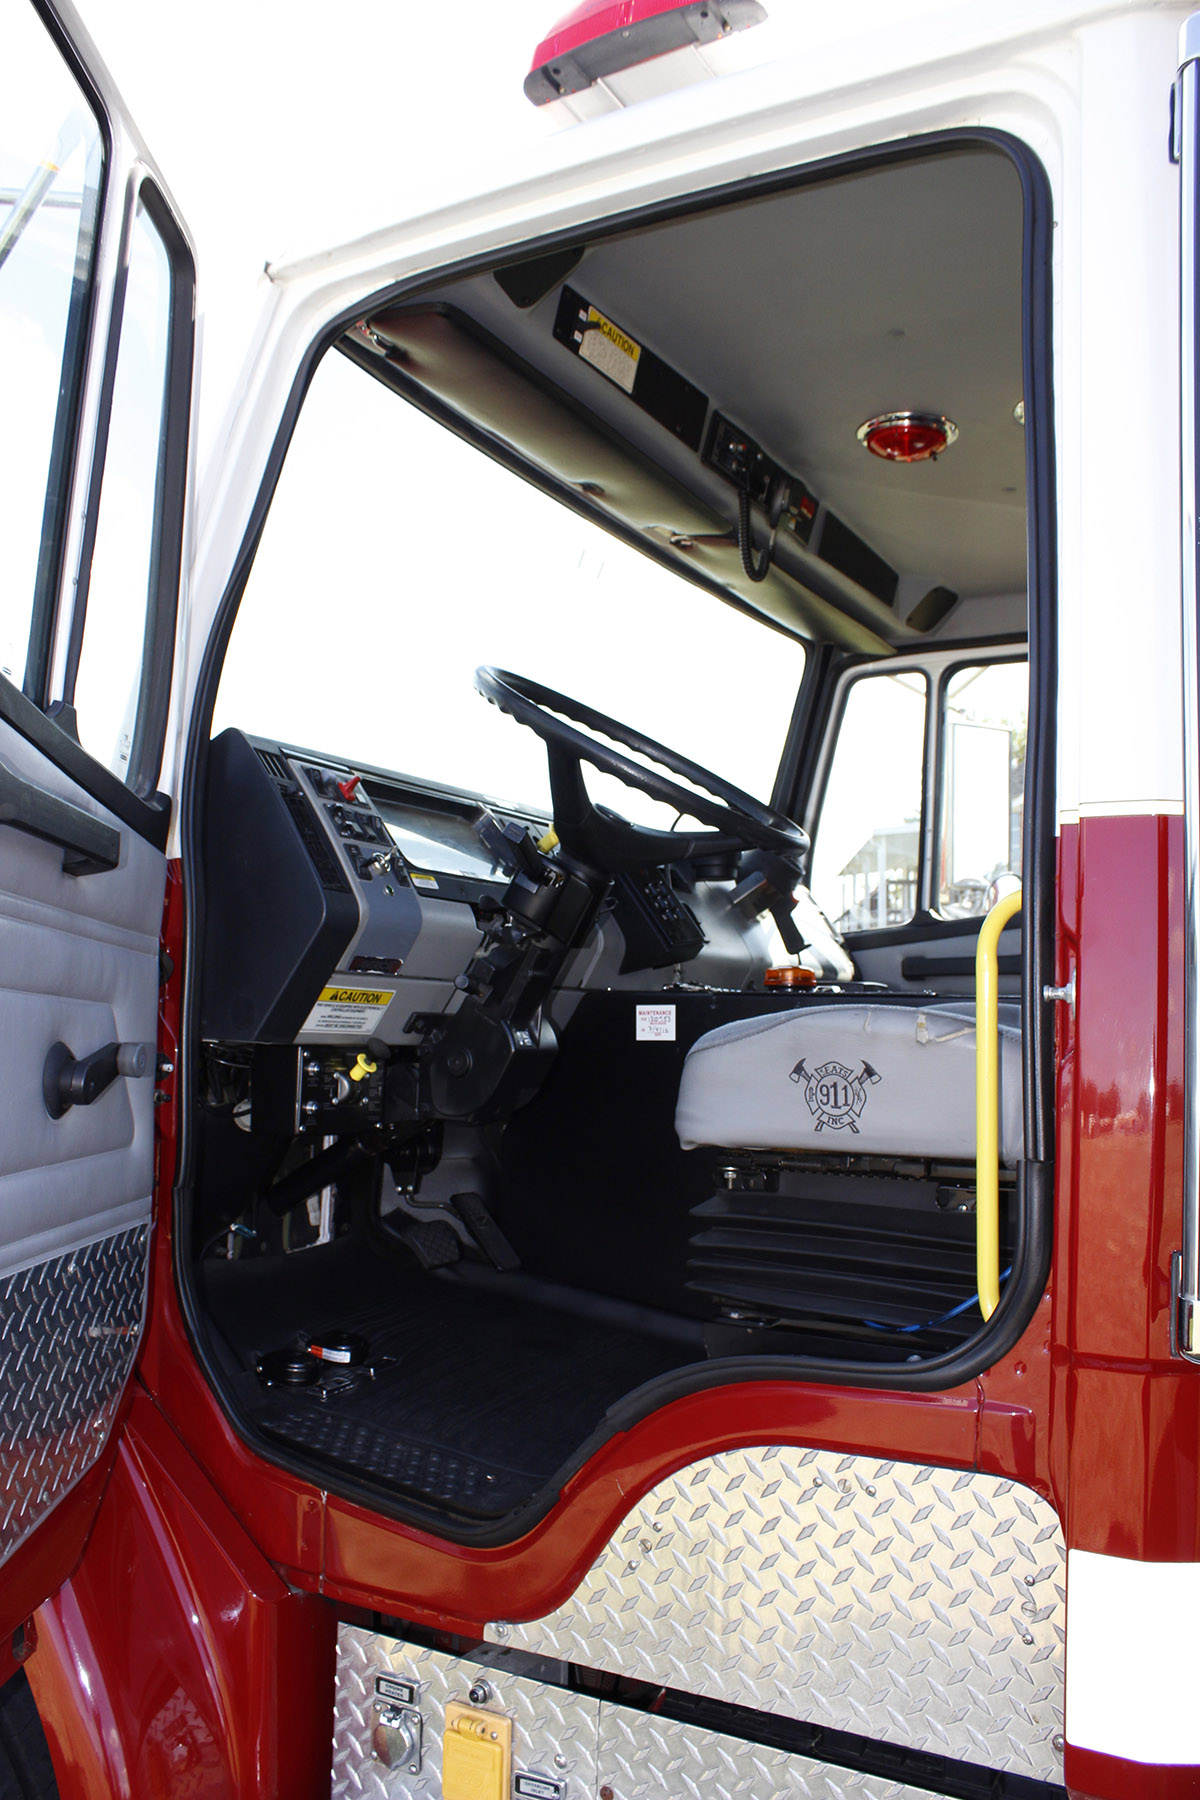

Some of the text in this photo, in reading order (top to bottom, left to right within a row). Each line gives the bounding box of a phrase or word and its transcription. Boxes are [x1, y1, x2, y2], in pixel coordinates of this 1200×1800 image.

[602, 322, 634, 356] CAUTION
[339, 991, 382, 1003] CAUTION
[820, 1066, 849, 1077] SEATS
[819, 1082, 850, 1109] 911
[827, 1117, 845, 1126] INC
[385, 1684, 403, 1692] ENGINE
[385, 1689, 403, 1697] HEATER
